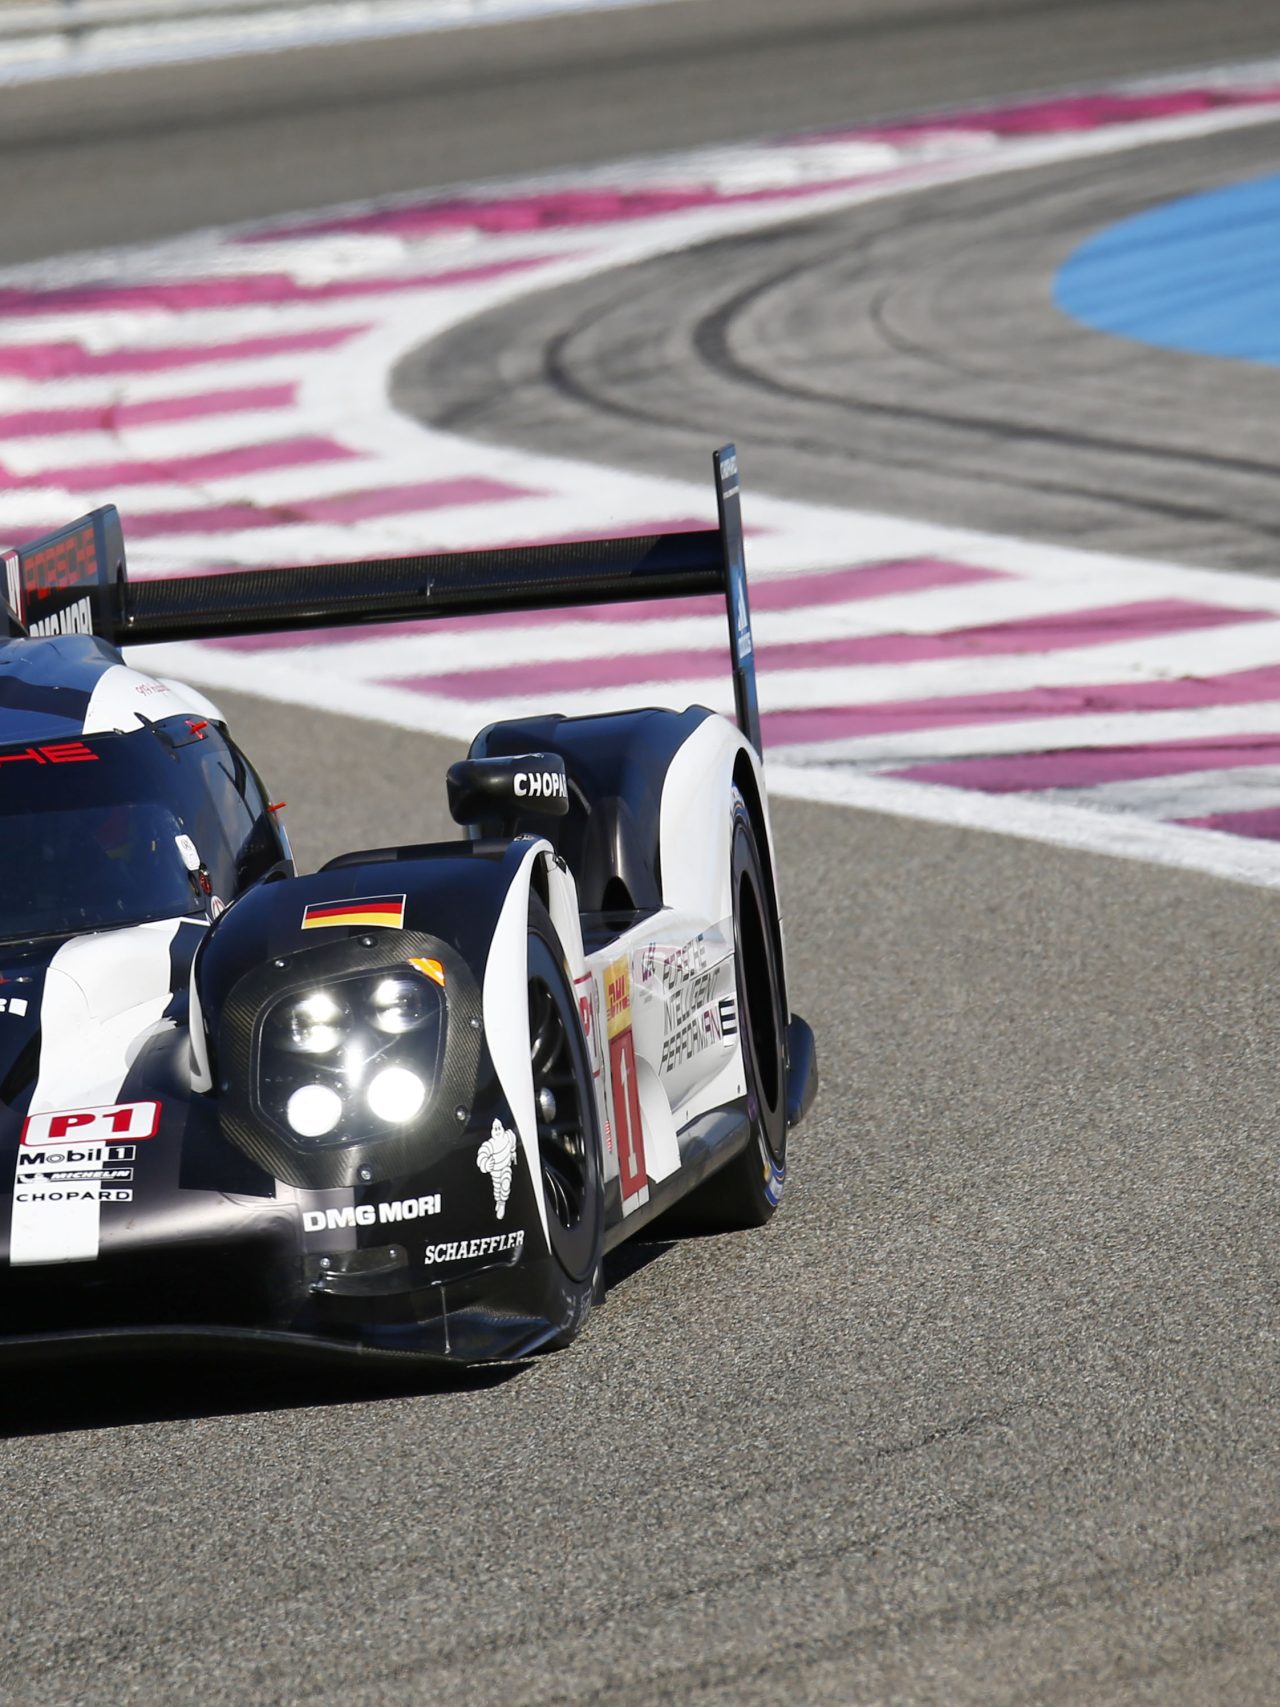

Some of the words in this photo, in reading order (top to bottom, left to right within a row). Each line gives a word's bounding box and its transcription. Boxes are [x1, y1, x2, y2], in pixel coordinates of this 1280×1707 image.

[24, 527, 97, 605] PORSCHE
[513, 772, 568, 797] CHOPA
[48, 1109, 133, 1138] P1
[621, 1048, 638, 1179] 1
[19, 1148, 101, 1166] Mobil
[51, 1170, 130, 1180] MICHELIN
[16, 1191, 130, 1202] CHOPARD
[303, 1204, 376, 1232] DMG
[379, 1194, 442, 1223] MORI
[424, 1229, 525, 1264] SCHAEFFLER
